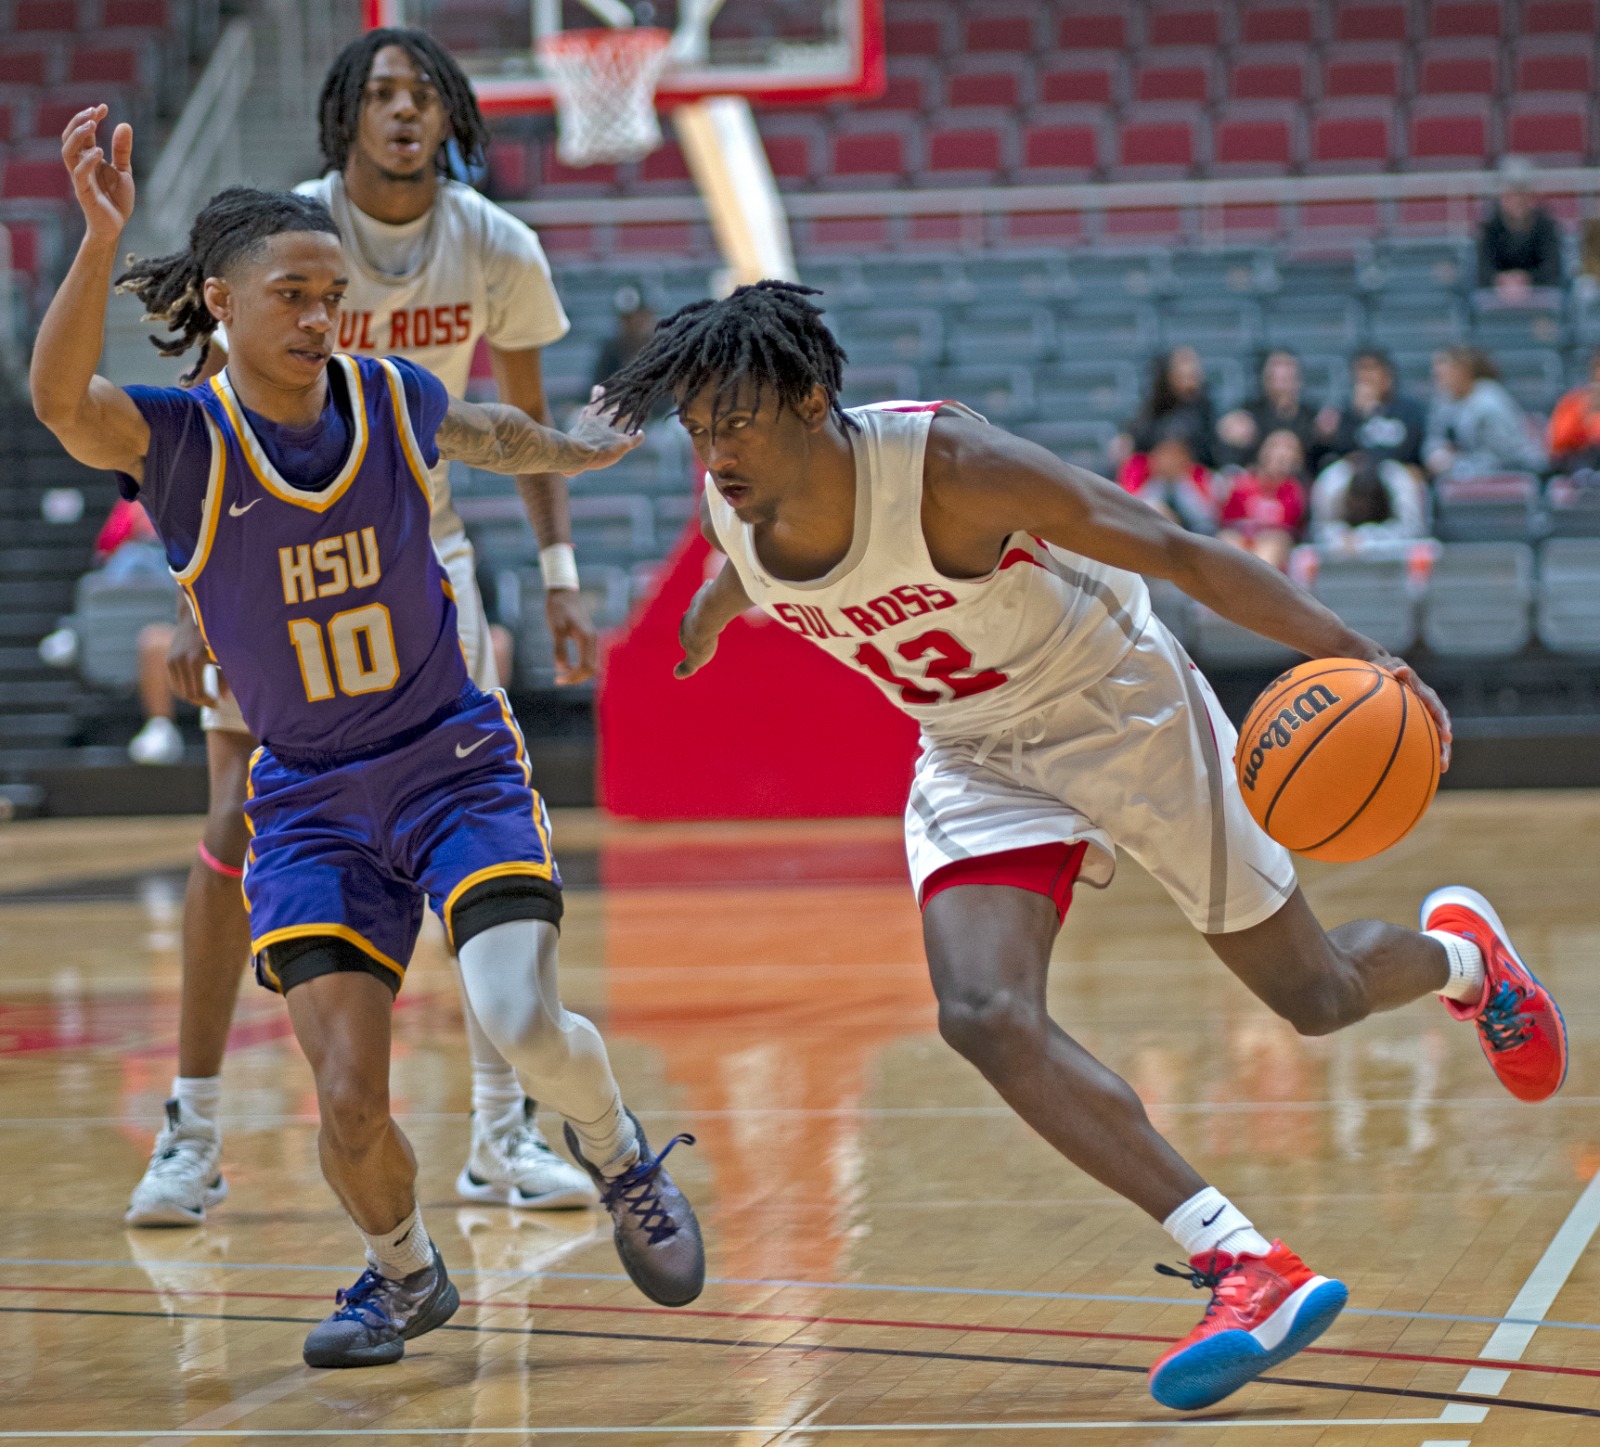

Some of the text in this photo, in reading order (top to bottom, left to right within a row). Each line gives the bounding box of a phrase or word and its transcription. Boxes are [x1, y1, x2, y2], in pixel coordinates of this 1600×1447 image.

[337, 303, 471, 349] UL ROSS
[278, 527, 381, 604] HSU
[772, 583, 958, 639] SUL ROSS
[287, 602, 400, 702] 10
[850, 627, 1009, 705] 12
[1242, 683, 1343, 792] Wilson
